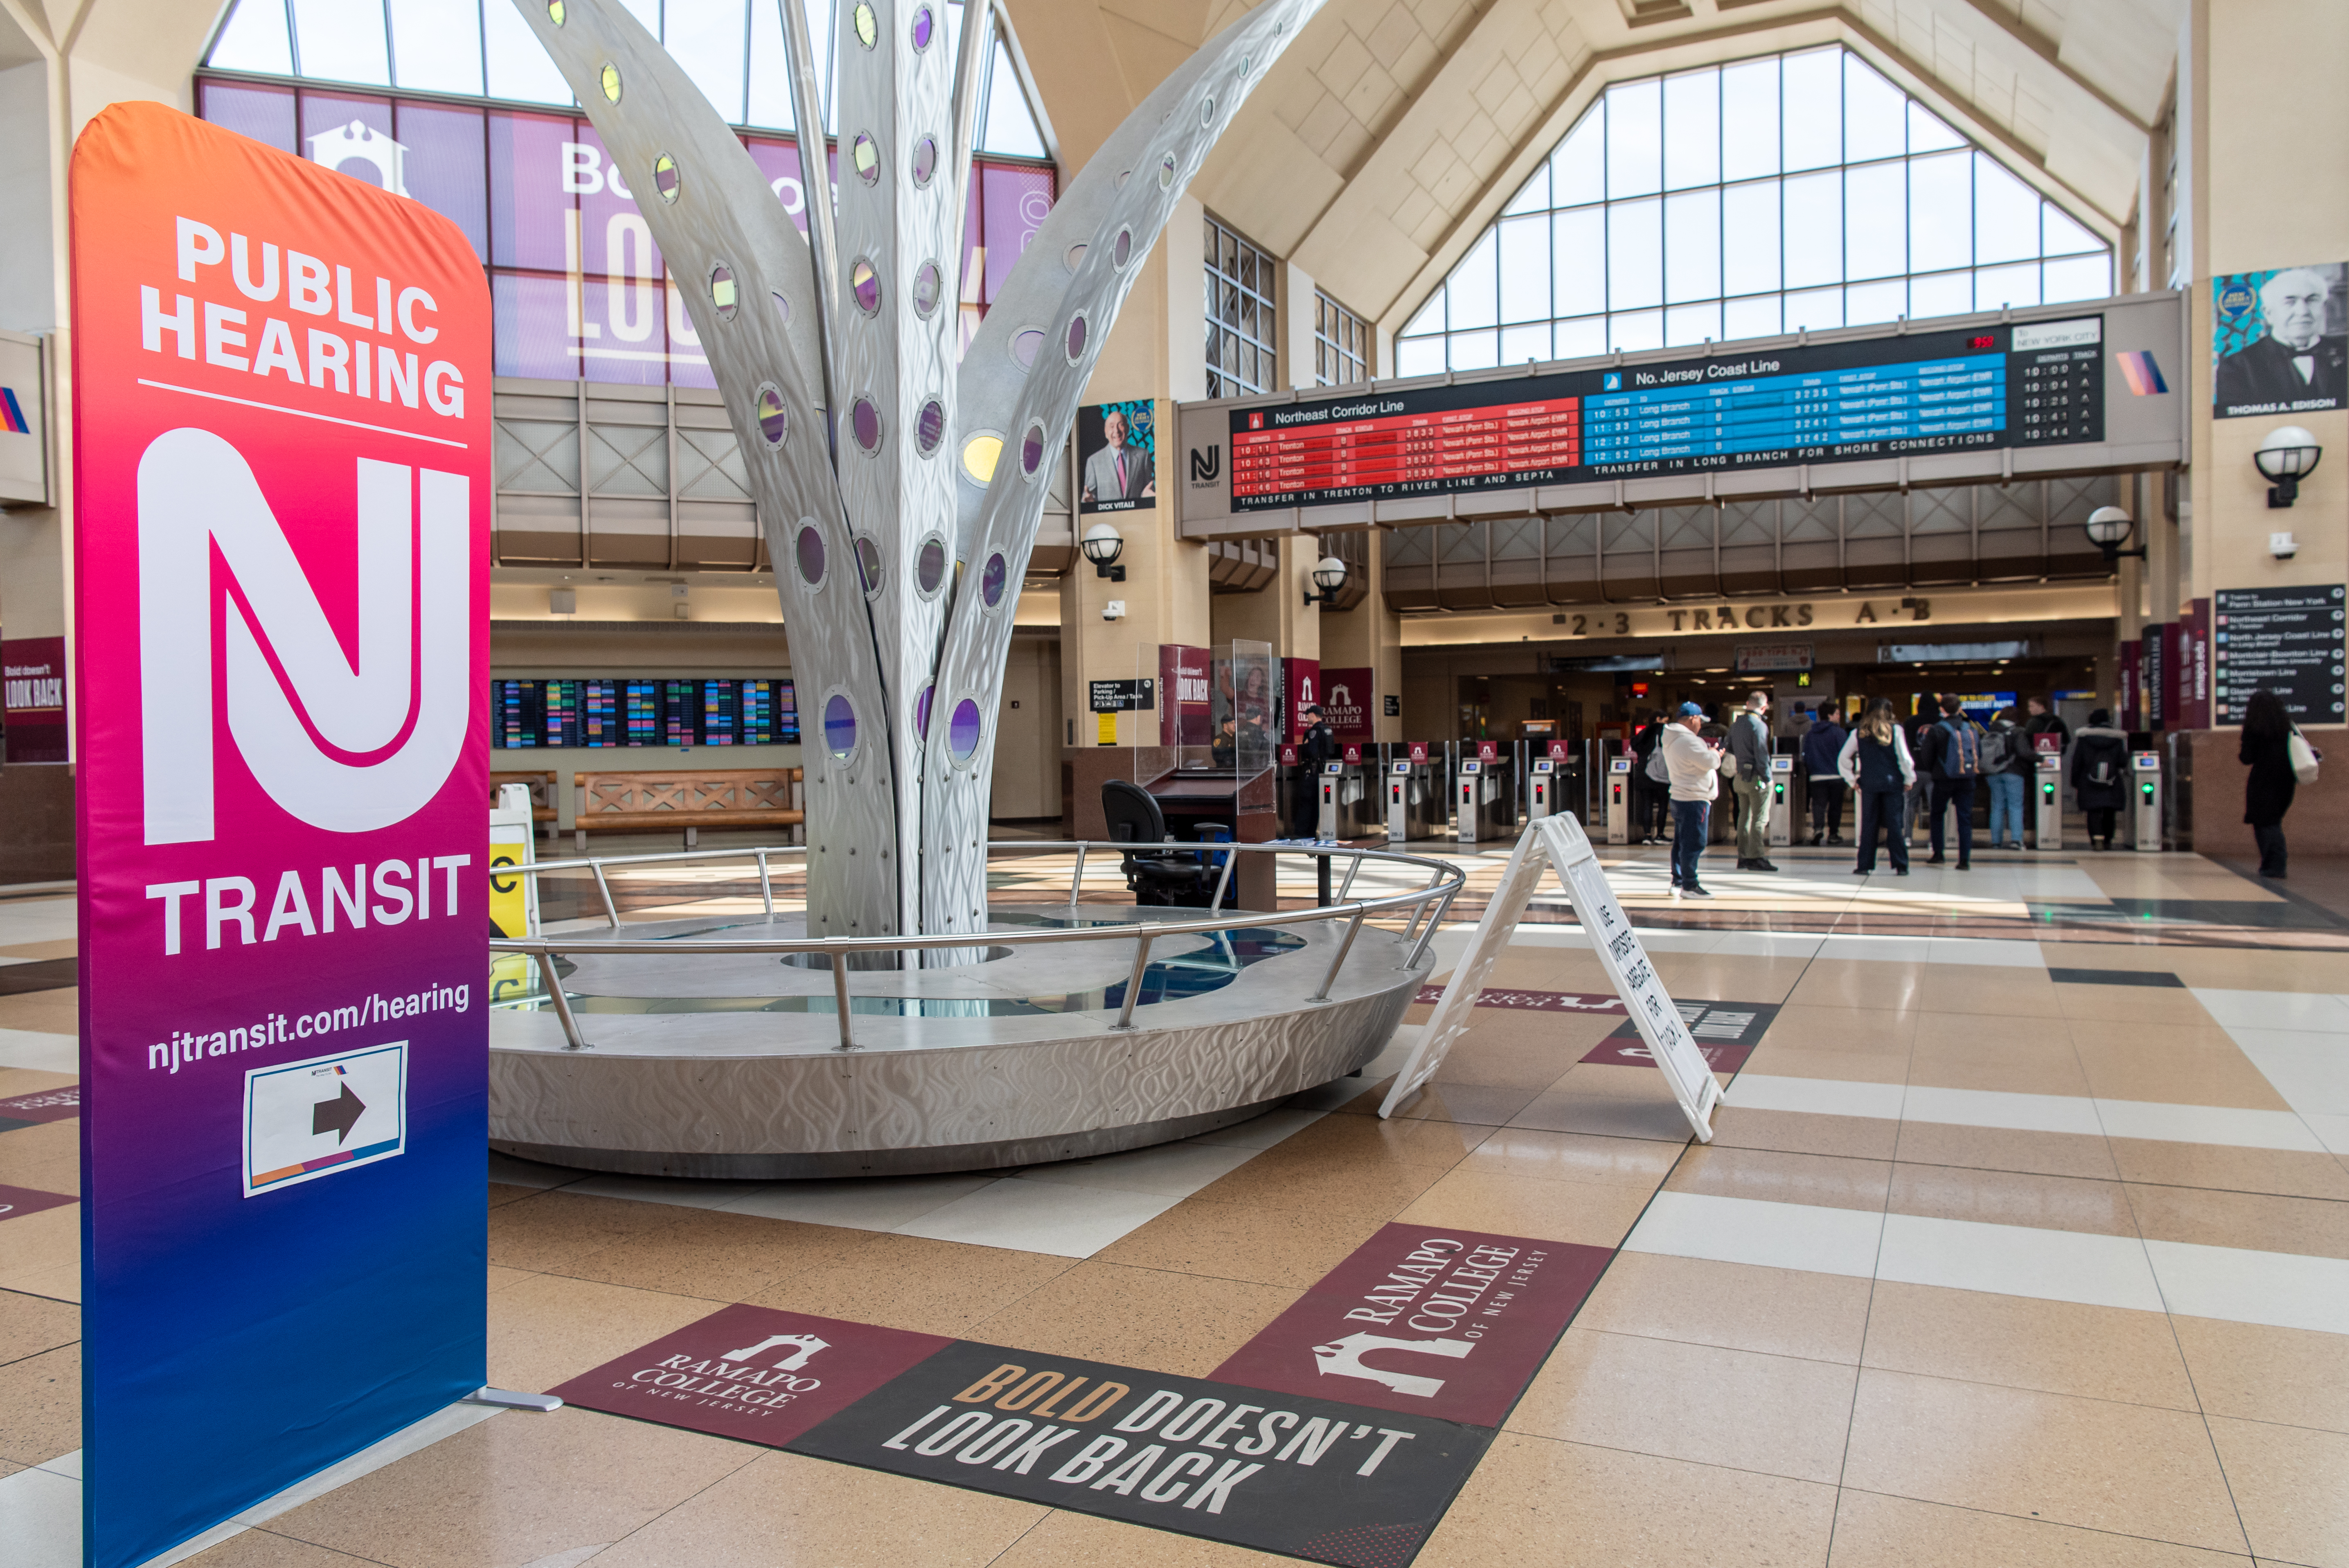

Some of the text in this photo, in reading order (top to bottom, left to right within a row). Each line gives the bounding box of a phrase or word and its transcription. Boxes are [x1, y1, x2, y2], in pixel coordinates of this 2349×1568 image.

[561, 142, 635, 199] Bo
[176, 216, 439, 344] PUBLIC
[2017, 330, 2098, 347] NEW YORK CITY
[141, 284, 464, 419] HEARING
[1636, 360, 1780, 385] No. Jersey Coast Line
[1275, 401, 1404, 424] Northeast Corridor Line
[1639, 404, 1660, 415] Long
[1661, 402, 1691, 412] Branch
[2226, 397, 2337, 415] THOMAS A. EDISON
[1639, 419, 1660, 429] Long
[1661, 416, 1691, 427] Branch
[1241, 445, 1270, 455] 10:11
[1278, 441, 1304, 451] Trenton
[1639, 433, 1660, 443] Long
[1661, 431, 1691, 441] Branch
[1191, 445, 1220, 481] NJ
[1241, 457, 1270, 467] 10:43
[1278, 454, 1304, 464] Trenton
[1595, 433, 1994, 475] TRANSFER IN LONG BRANCH FOR SHORE CONNECTIONS
[1639, 448, 1660, 457] Long
[1661, 445, 1691, 455] Branch
[1278, 466, 1304, 476] Trenton
[1191, 481, 1220, 489] TRANSIT
[1241, 471, 1554, 505] TRANSFER IN TRENTON TO RIVER LINE AND SEPTA
[1278, 480, 1304, 489] Trenton
[1098, 501, 1135, 511] DICK VITALE
[2252, 599, 2283, 608] Station
[2283, 598, 2304, 606] New
[1572, 615, 1587, 635] 2
[1615, 613, 1630, 634] 3
[1667, 604, 1813, 631] TRACKS
[1855, 602, 1877, 624] A
[2271, 614, 2308, 622] Corridor
[137, 428, 470, 845] NJ
[2254, 633, 2283, 642] Jersey
[2283, 632, 2310, 640] Coast
[5, 665, 21, 677] Bold
[5, 678, 63, 708] LOOK BACK
[1193, 678, 1208, 701] BACK
[1322, 706, 1362, 715] RAMAPO
[1322, 716, 1362, 724] COLLEGE
[146, 854, 471, 955] TRANSIT
[1597, 904, 1615, 928] USE
[1608, 929, 1635, 962] OPPOSITE
[1645, 994, 1662, 1020] FOR
[149, 982, 469, 1074] njtransit.com/hearing
[1343, 1239, 1464, 1326] RAMAPO
[1408, 1244, 1520, 1332] COLLEGE
[1464, 1250, 1548, 1338] OF NEW JERSEY
[655, 1354, 821, 1392] RAMAPO
[612, 1381, 774, 1417] OF NEW JERSEY
[632, 1368, 798, 1408] COLLEGE
[952, 1363, 1416, 1477] BOLD DOESN'T
[881, 1404, 1266, 1515] LOOK BACK
